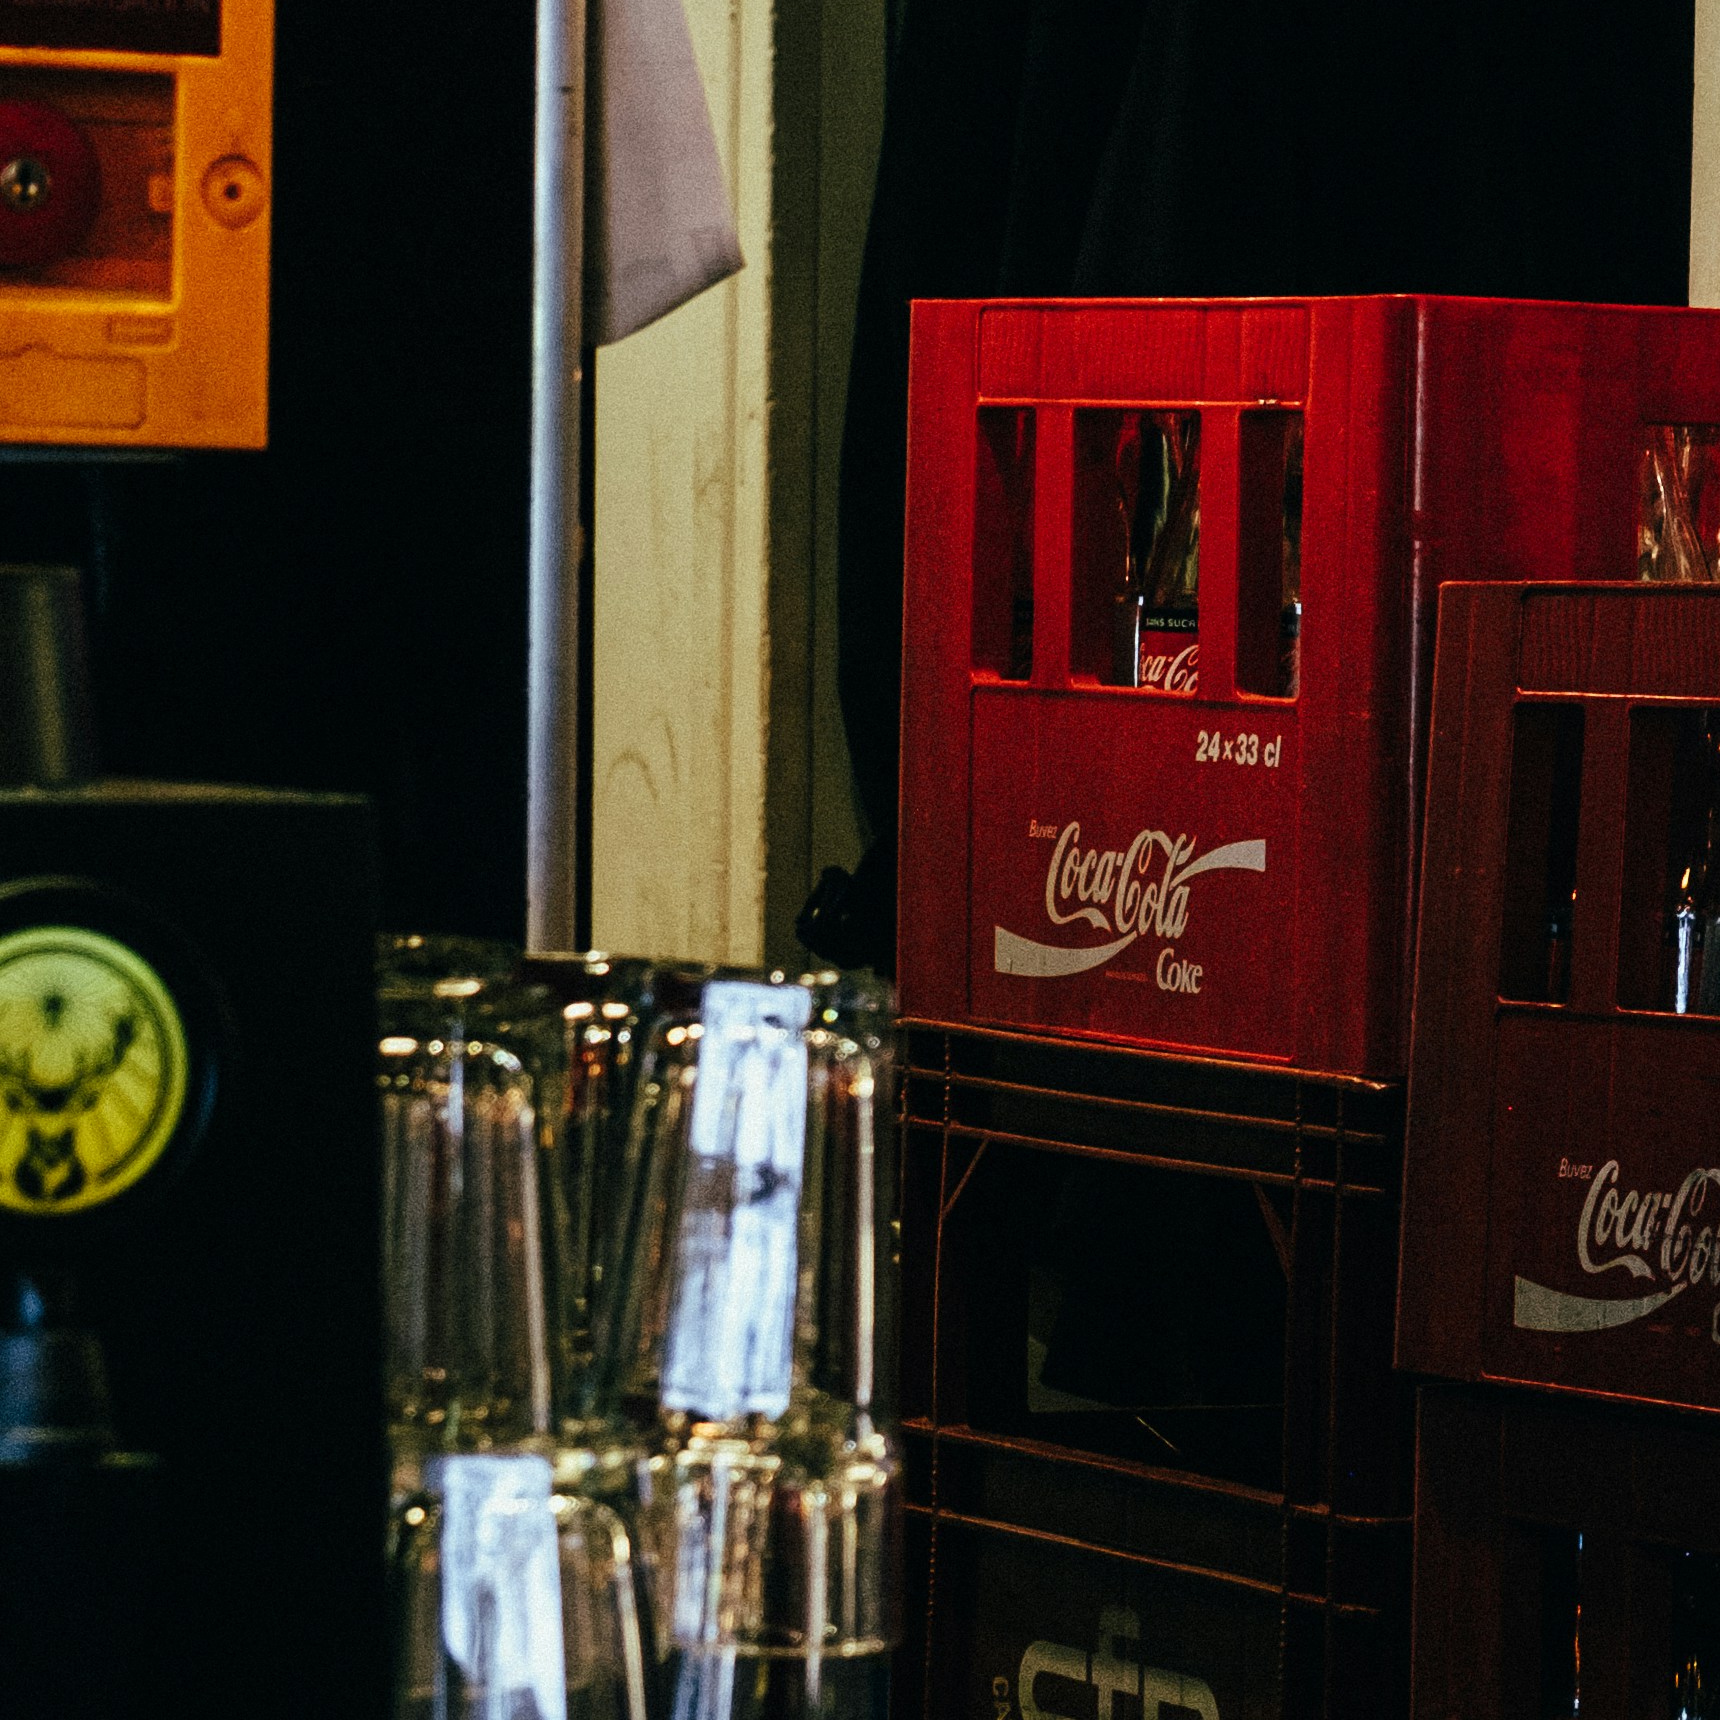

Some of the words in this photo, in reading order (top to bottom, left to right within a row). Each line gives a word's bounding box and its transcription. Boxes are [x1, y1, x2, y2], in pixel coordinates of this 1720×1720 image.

[1263, 732, 1281, 768] cl
[1045, 820, 1197, 940] Coca-Cola
[1156, 947, 1203, 995] Coke
